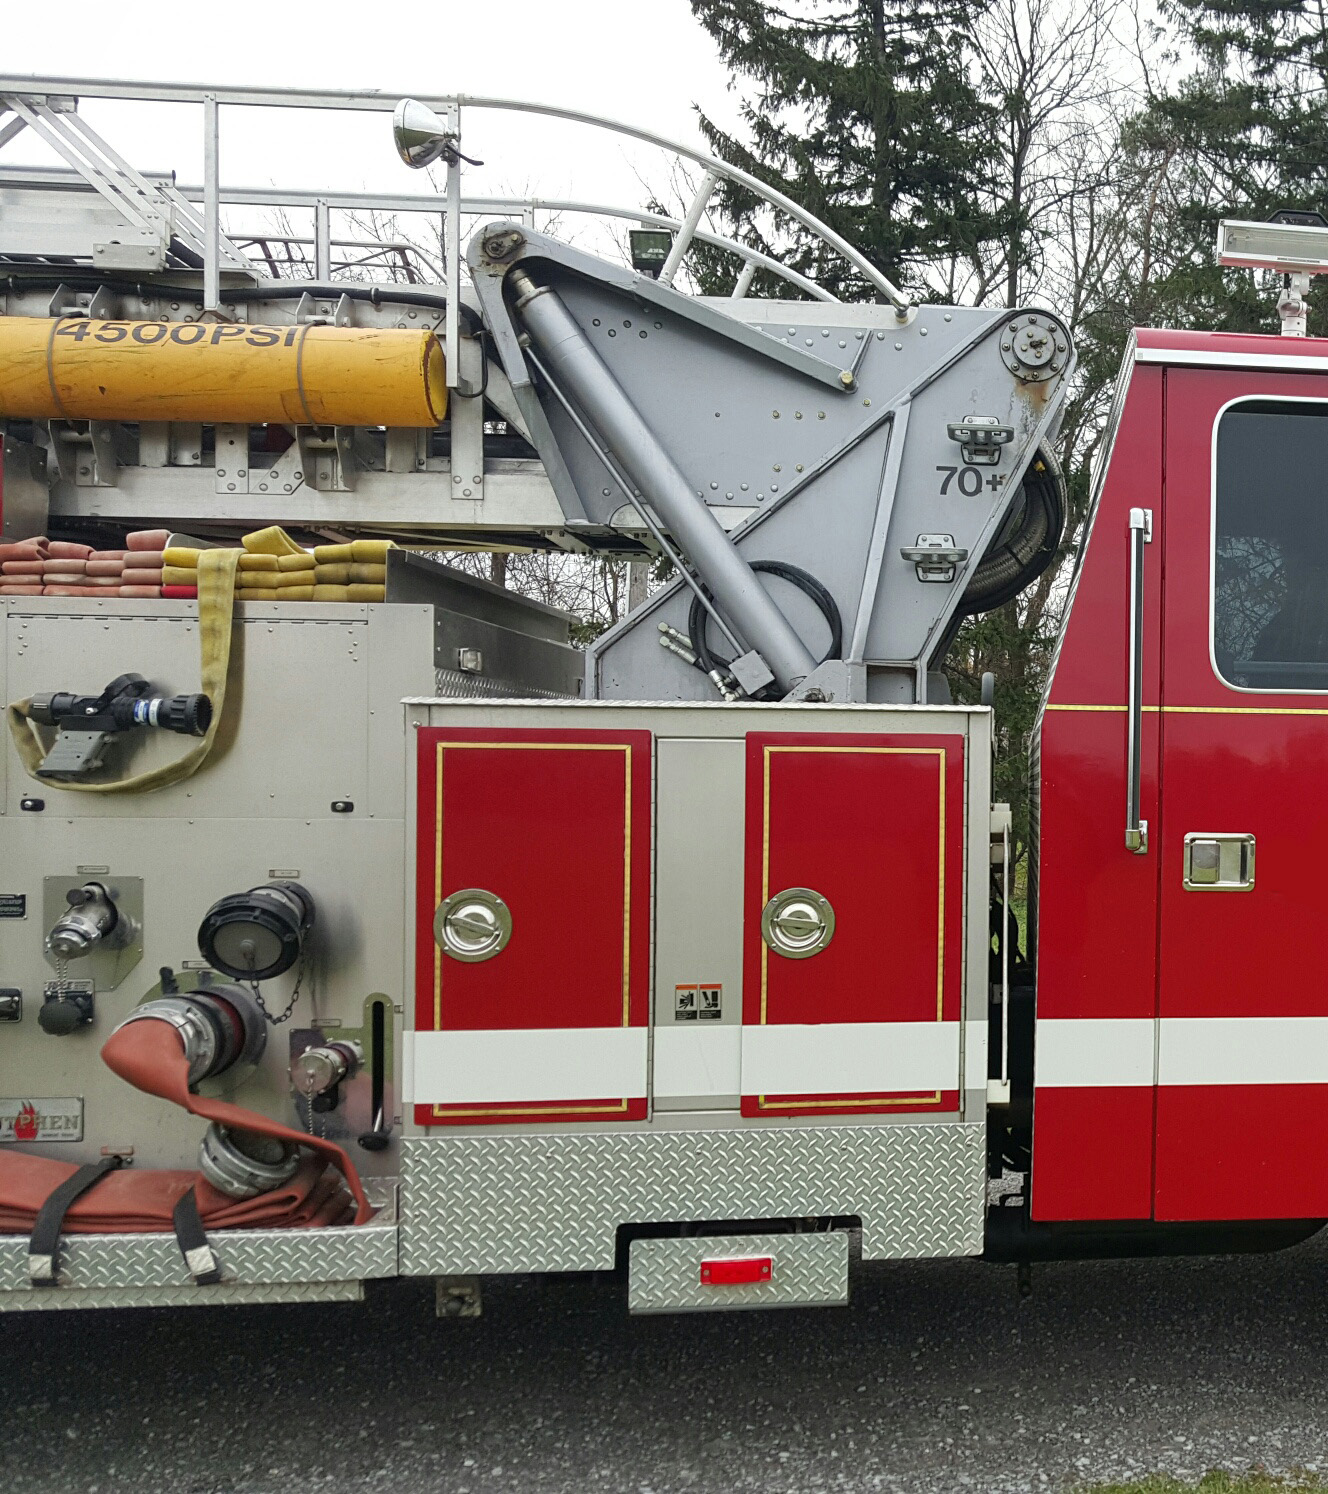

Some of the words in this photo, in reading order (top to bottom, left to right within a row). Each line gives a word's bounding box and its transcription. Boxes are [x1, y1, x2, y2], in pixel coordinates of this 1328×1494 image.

[56, 321, 298, 347] 4500PSI
[936, 465, 1003, 497] 70+
[0, 1114, 79, 1130] TPHEN
